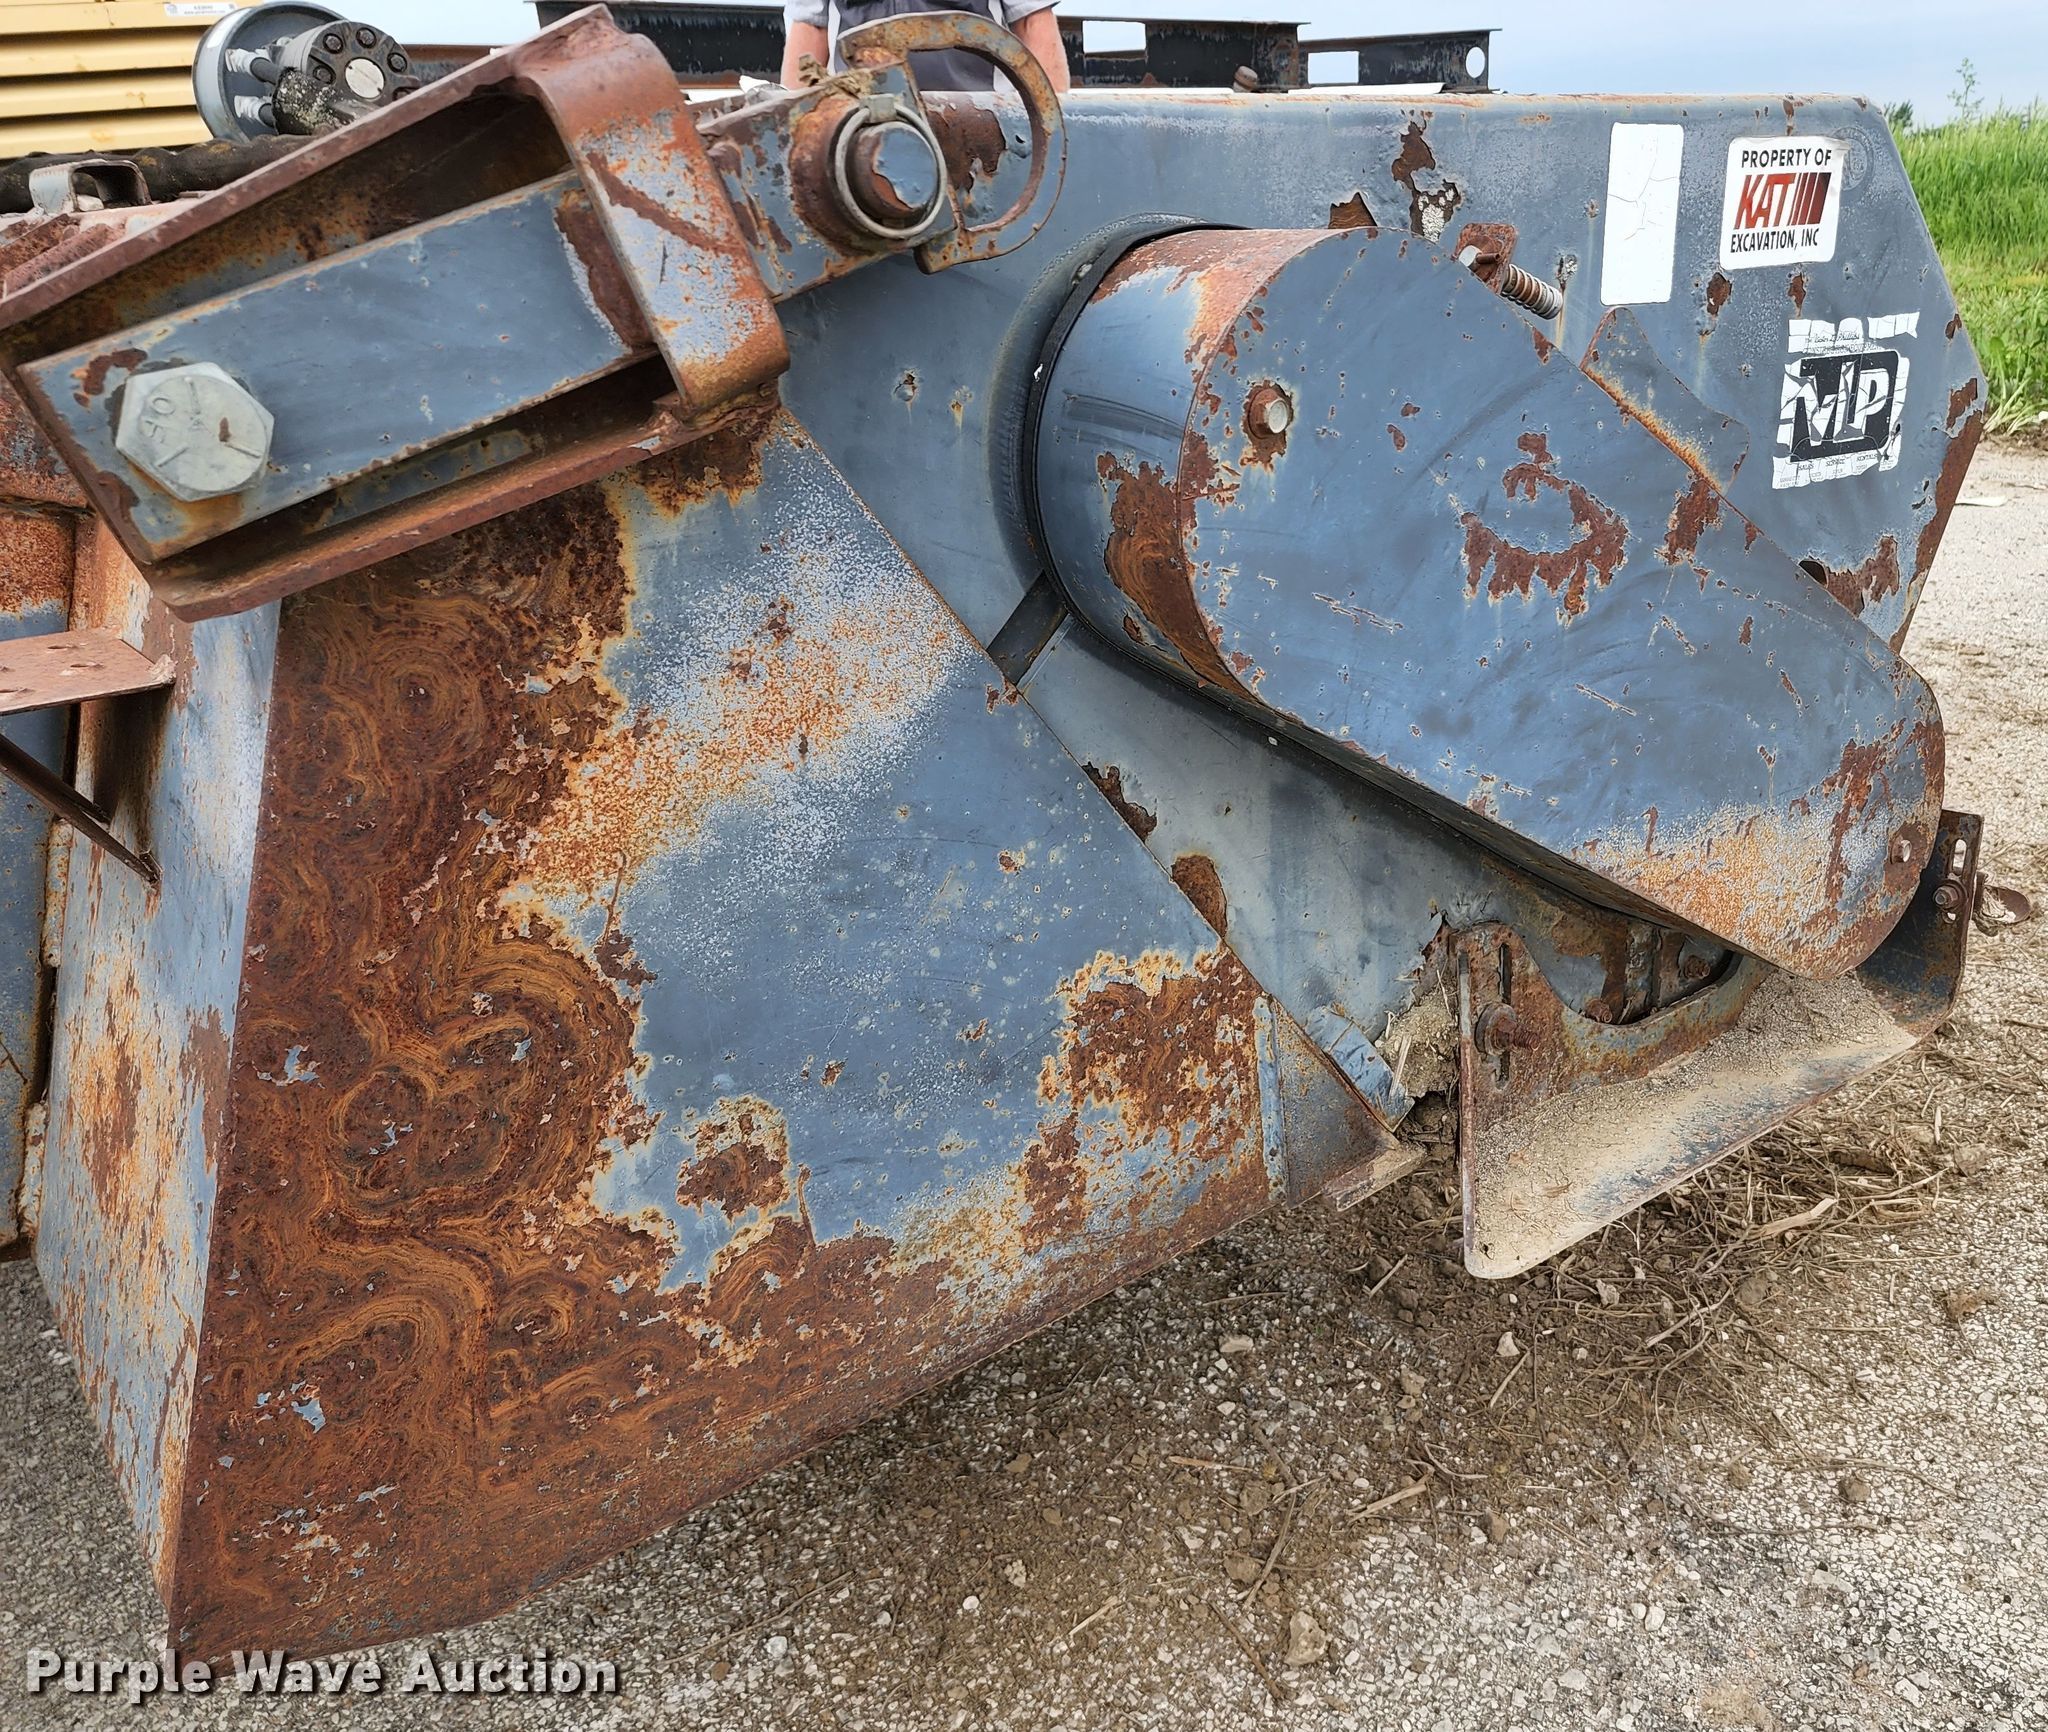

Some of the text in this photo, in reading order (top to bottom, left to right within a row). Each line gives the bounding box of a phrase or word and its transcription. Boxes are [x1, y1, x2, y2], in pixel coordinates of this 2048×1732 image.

[1741, 148, 1832, 168] PROPERTY OF
[1733, 173, 1796, 229] KAT
[1730, 228, 1819, 253] EXCAVATION, INC
